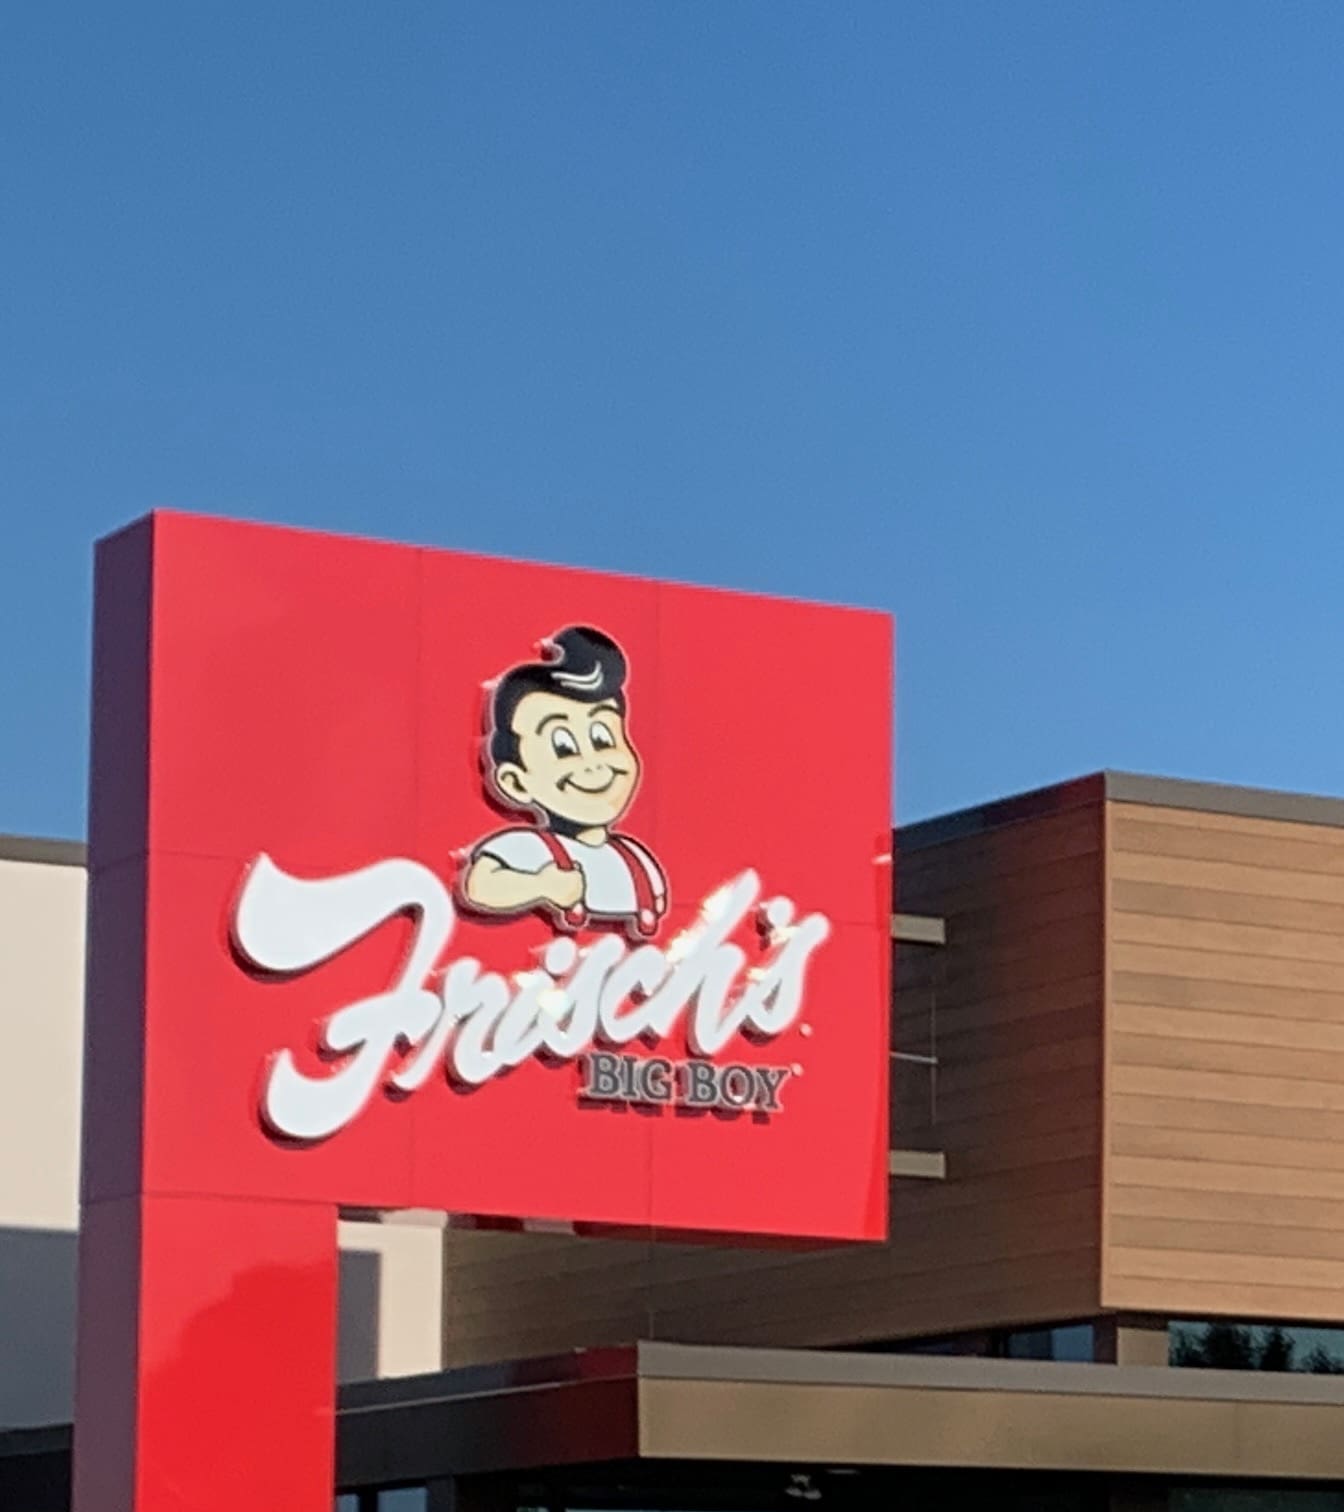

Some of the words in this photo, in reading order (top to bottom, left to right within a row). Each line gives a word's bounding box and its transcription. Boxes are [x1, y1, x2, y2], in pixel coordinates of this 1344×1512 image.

[233, 851, 830, 1139] Frisch's
[589, 1052, 673, 1101] BIG
[686, 1060, 788, 1111] BOY
